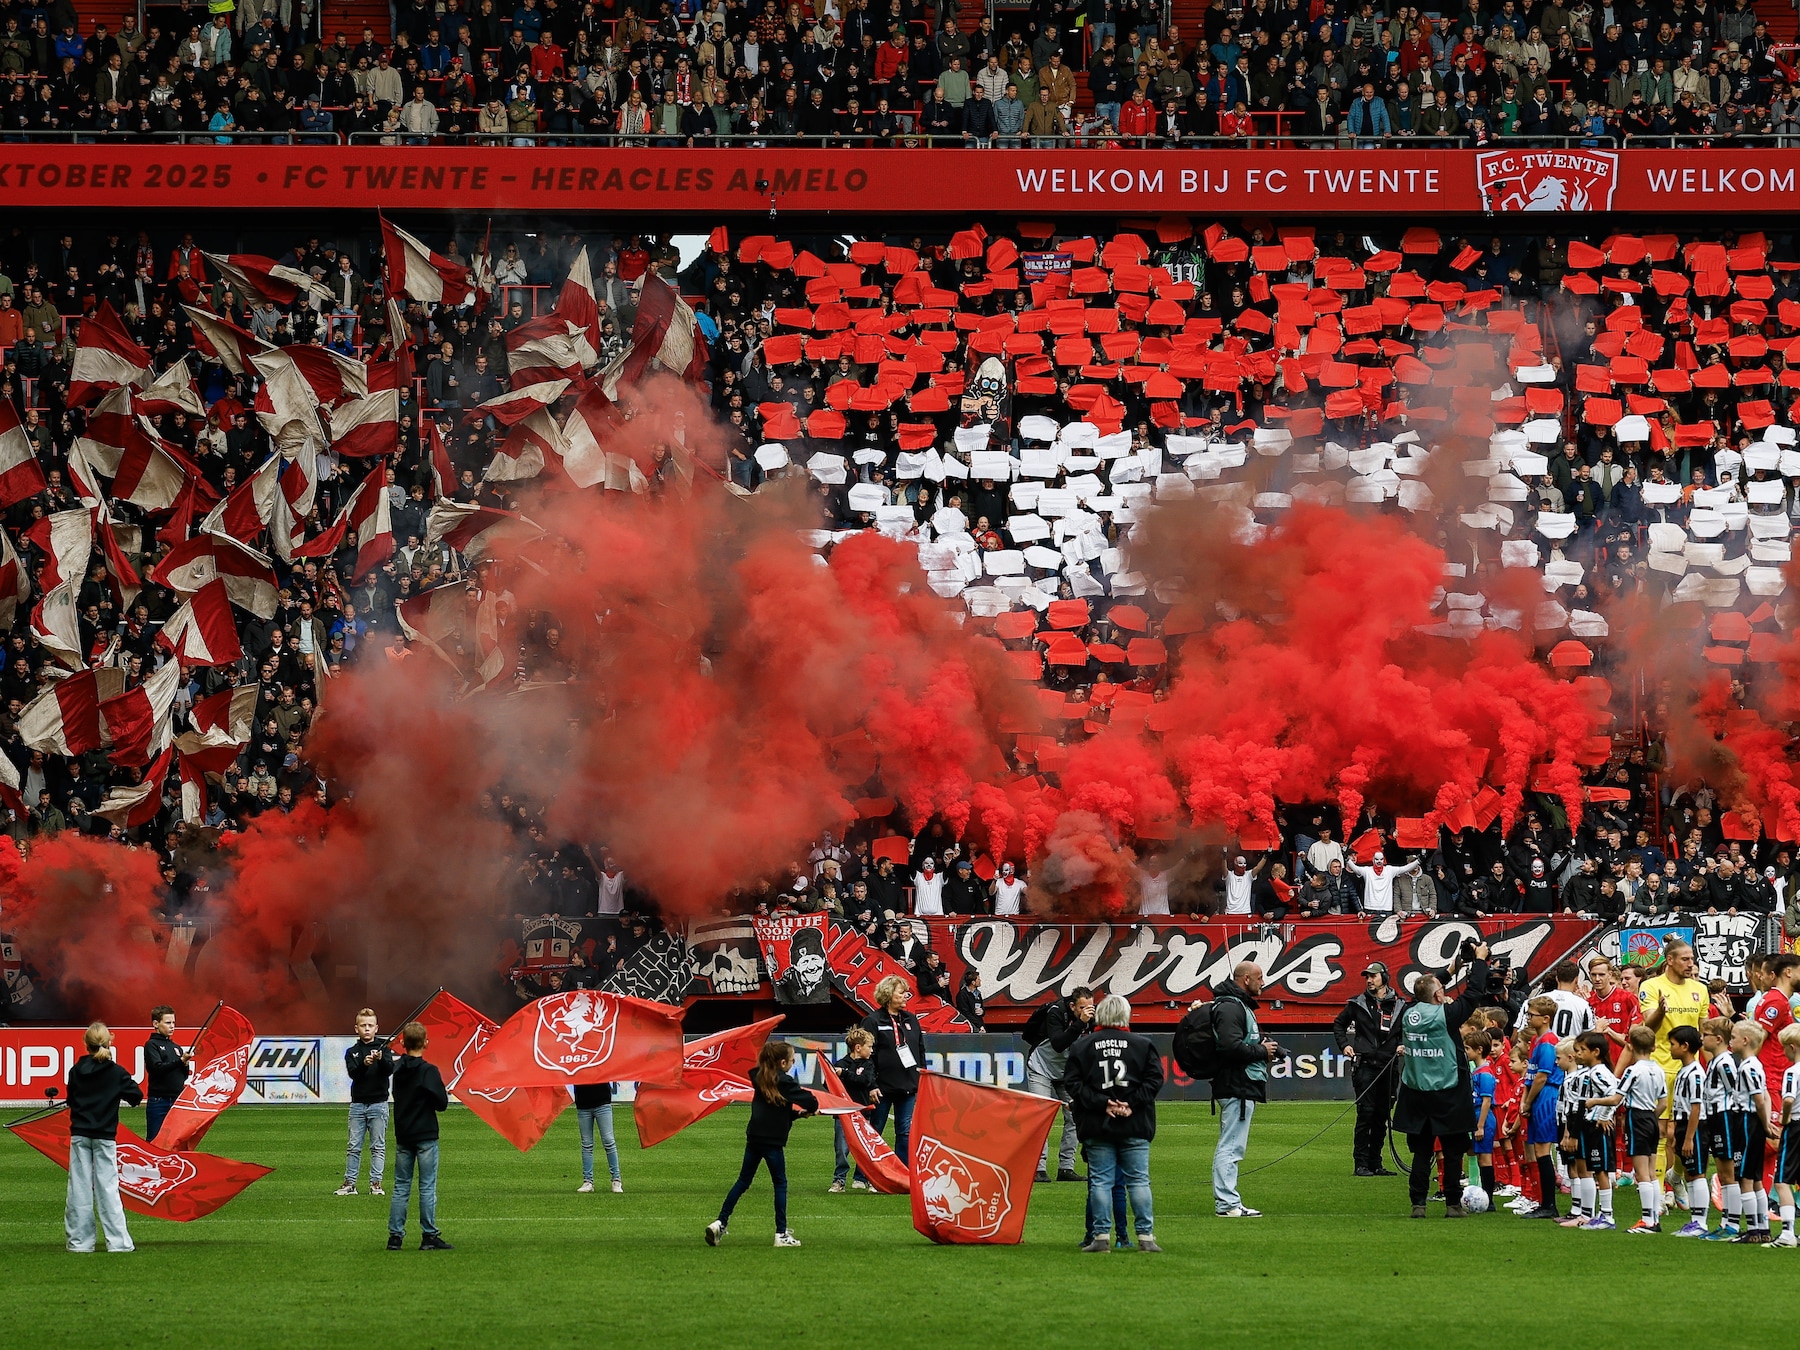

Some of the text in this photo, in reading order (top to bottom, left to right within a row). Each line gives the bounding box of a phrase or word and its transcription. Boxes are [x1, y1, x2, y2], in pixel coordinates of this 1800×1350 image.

[144, 164, 232, 188] 2025
[1486, 153, 1610, 178] F.C. TWENTE
[283, 166, 329, 189] FC
[342, 166, 489, 190] TWENTE
[531, 167, 714, 192] HERACLES
[726, 168, 869, 192] ALMELO
[1016, 168, 1440, 193] WELKOM BIJ FC TWENTE
[1646, 168, 1795, 193] WELKOM
[961, 920, 1343, 1000] Ultras
[1667, 1006, 1699, 1015] gmgastro
[1094, 1039, 1128, 1050] KIDSCLUB
[1102, 1048, 1122, 1058] CREW
[1412, 1048, 1445, 1058] MEDIA
[254, 1048, 306, 1068] HH
[559, 1053, 588, 1064] 1965
[1098, 1059, 1129, 1090] 12
